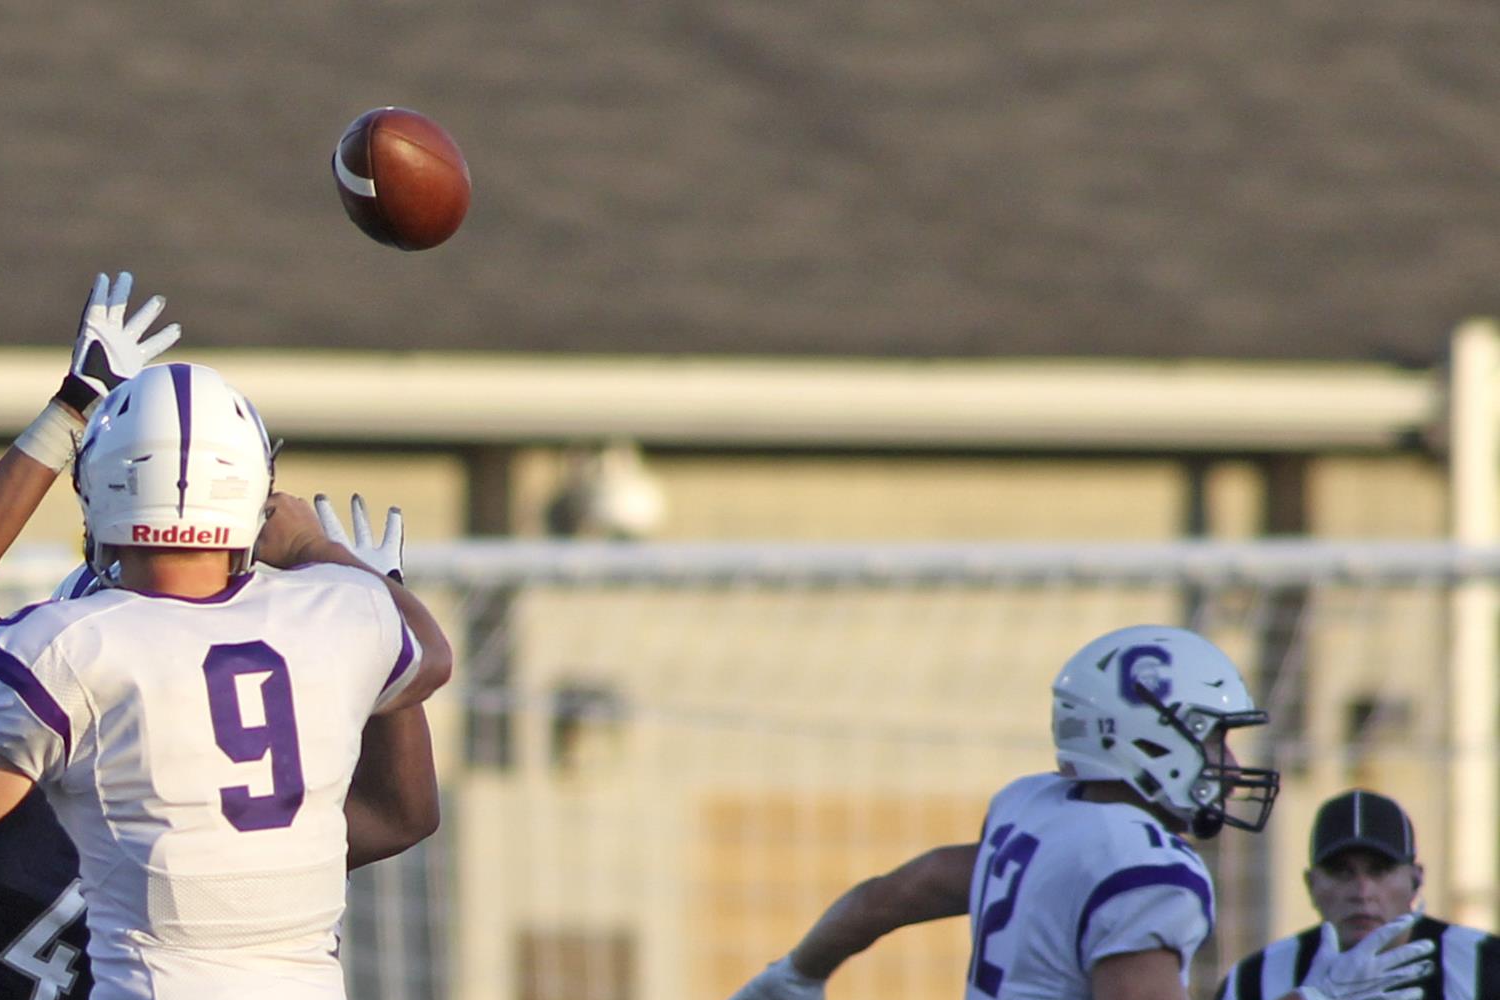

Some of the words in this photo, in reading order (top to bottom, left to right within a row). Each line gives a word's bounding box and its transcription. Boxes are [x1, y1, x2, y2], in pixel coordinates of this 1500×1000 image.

[132, 524, 230, 544] Riddell
[202, 640, 305, 831] 9
[1098, 718, 1115, 734] 12
[968, 823, 1041, 999] 12
